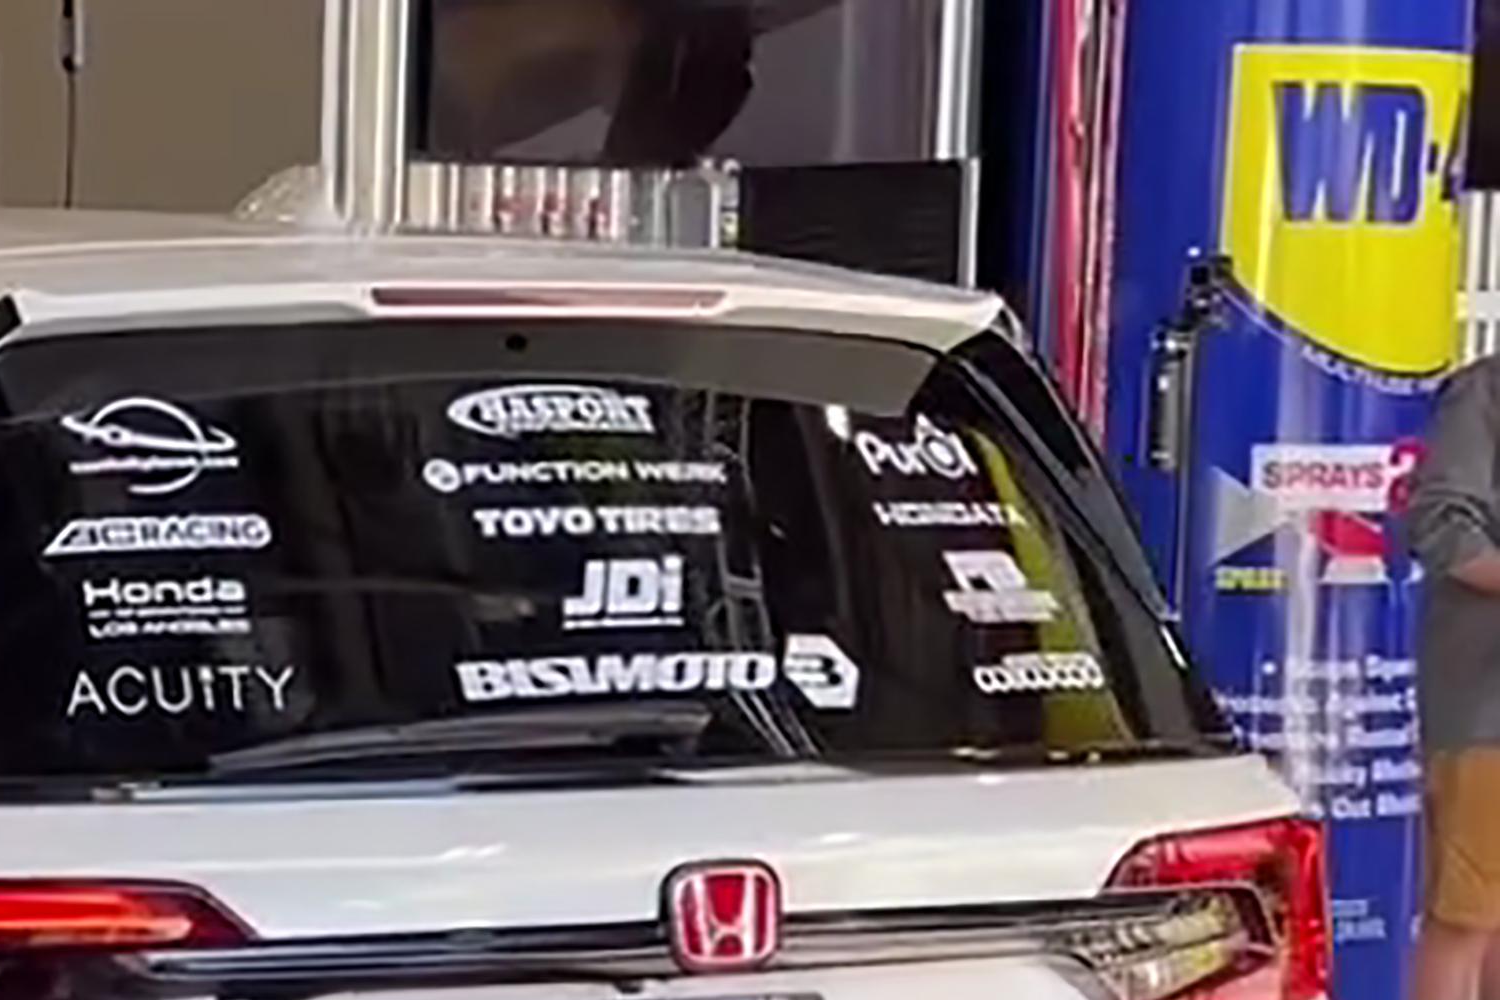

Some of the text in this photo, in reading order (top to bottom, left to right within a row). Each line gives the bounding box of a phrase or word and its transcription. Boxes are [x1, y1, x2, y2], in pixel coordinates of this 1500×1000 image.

[463, 459, 628, 484] FUNCTION
[472, 504, 722, 537] TOYO TIRES
[82, 576, 247, 607] Honda
[65, 664, 295, 717] ACUITY
